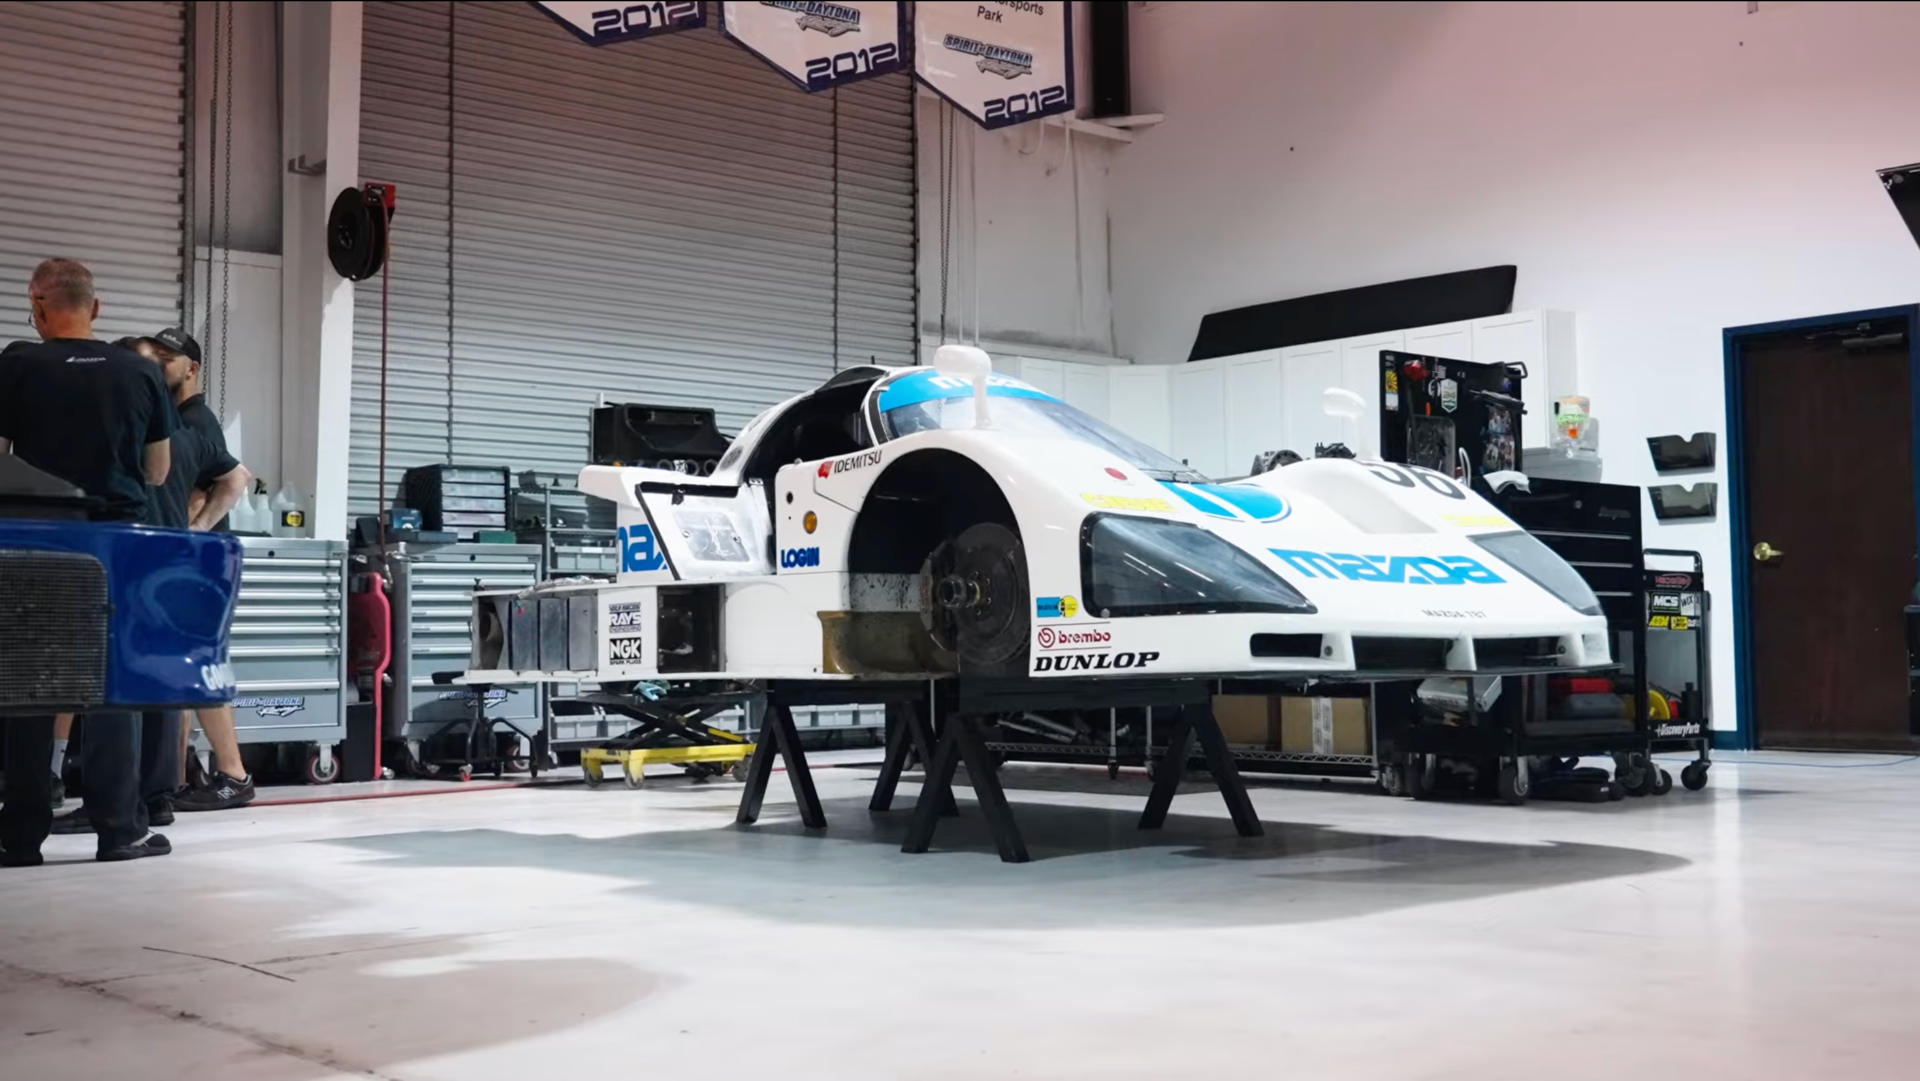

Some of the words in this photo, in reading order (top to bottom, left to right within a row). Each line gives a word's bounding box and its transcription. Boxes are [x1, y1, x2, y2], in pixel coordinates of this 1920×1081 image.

[592, 2, 696, 37] 2012
[977, 6, 1003, 23] Park
[945, 35, 979, 53] SPIRIT
[985, 46, 1031, 66] DAYTONA
[805, 43, 898, 83] 2012
[984, 85, 1065, 120] 2012
[834, 450, 882, 473] IDEMITSU
[1653, 595, 1679, 607] MCS
[609, 611, 642, 626] RAYS
[1421, 609, 1466, 618] MAZDA
[1059, 629, 1111, 644] brembo
[610, 638, 641, 659] NGK
[1034, 652, 1160, 672] DUNLOP
